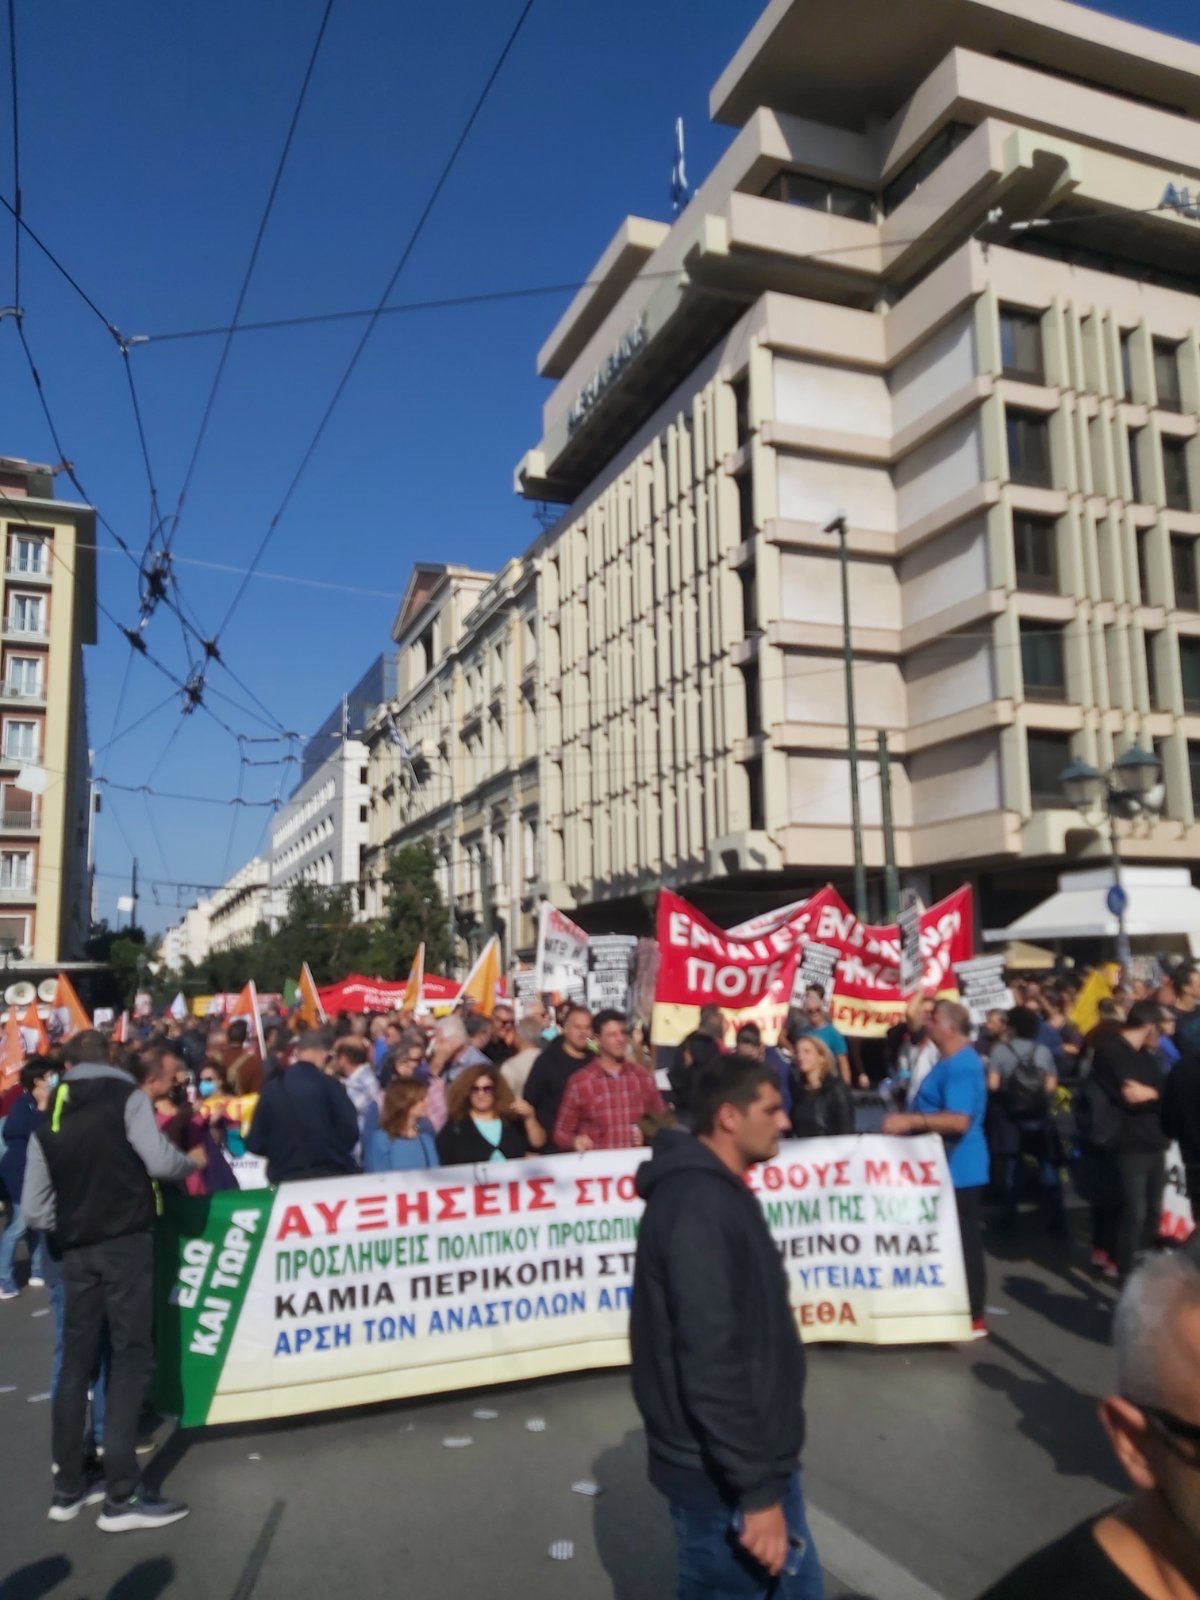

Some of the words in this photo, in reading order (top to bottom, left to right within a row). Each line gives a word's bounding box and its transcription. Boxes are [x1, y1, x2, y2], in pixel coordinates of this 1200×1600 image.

[686, 956, 784, 997] ΠΟΤΕ
[275, 1234, 430, 1283] ΠΡΟΣΛΗΨΕΙΣ
[438, 1226, 540, 1263] ΠΟΛΙΤΙΚΟΥ
[766, 1198, 820, 1229] ΜΥΝΑ
[828, 1195, 865, 1222] ΤΗΣ
[276, 1177, 556, 1241] ΑΥΞΗΣΕΙΣ
[575, 1175, 637, 1205] ΣΤΟ
[742, 1160, 850, 1193] ΣΘΟΥΣ
[865, 1160, 941, 1187] ΜΑΣ
[178, 1238, 215, 1308] ΕΔΩ
[209, 1207, 261, 1289] ΤΩΡΑ
[274, 1281, 395, 1320] ΚΑΜΙΑ
[410, 1256, 584, 1301] ΠΕΡΙΚΟΠΗ
[598, 1252, 635, 1276] ΣΤ
[875, 1233, 941, 1256] ΜΑΣ
[189, 1295, 232, 1356] ΚΑΙ
[274, 1323, 351, 1357] ΑΡΣΗ
[363, 1313, 416, 1343] ΤΩΝ
[428, 1290, 587, 1336] ΑΝΑΣΤΟΛΩΝ
[597, 1286, 635, 1312] ΑΠ
[799, 1266, 882, 1290] ΥΓΕΙΑΣ
[892, 1264, 945, 1287] ΜΑΣ
[794, 1301, 857, 1328] ΕΘΑ
